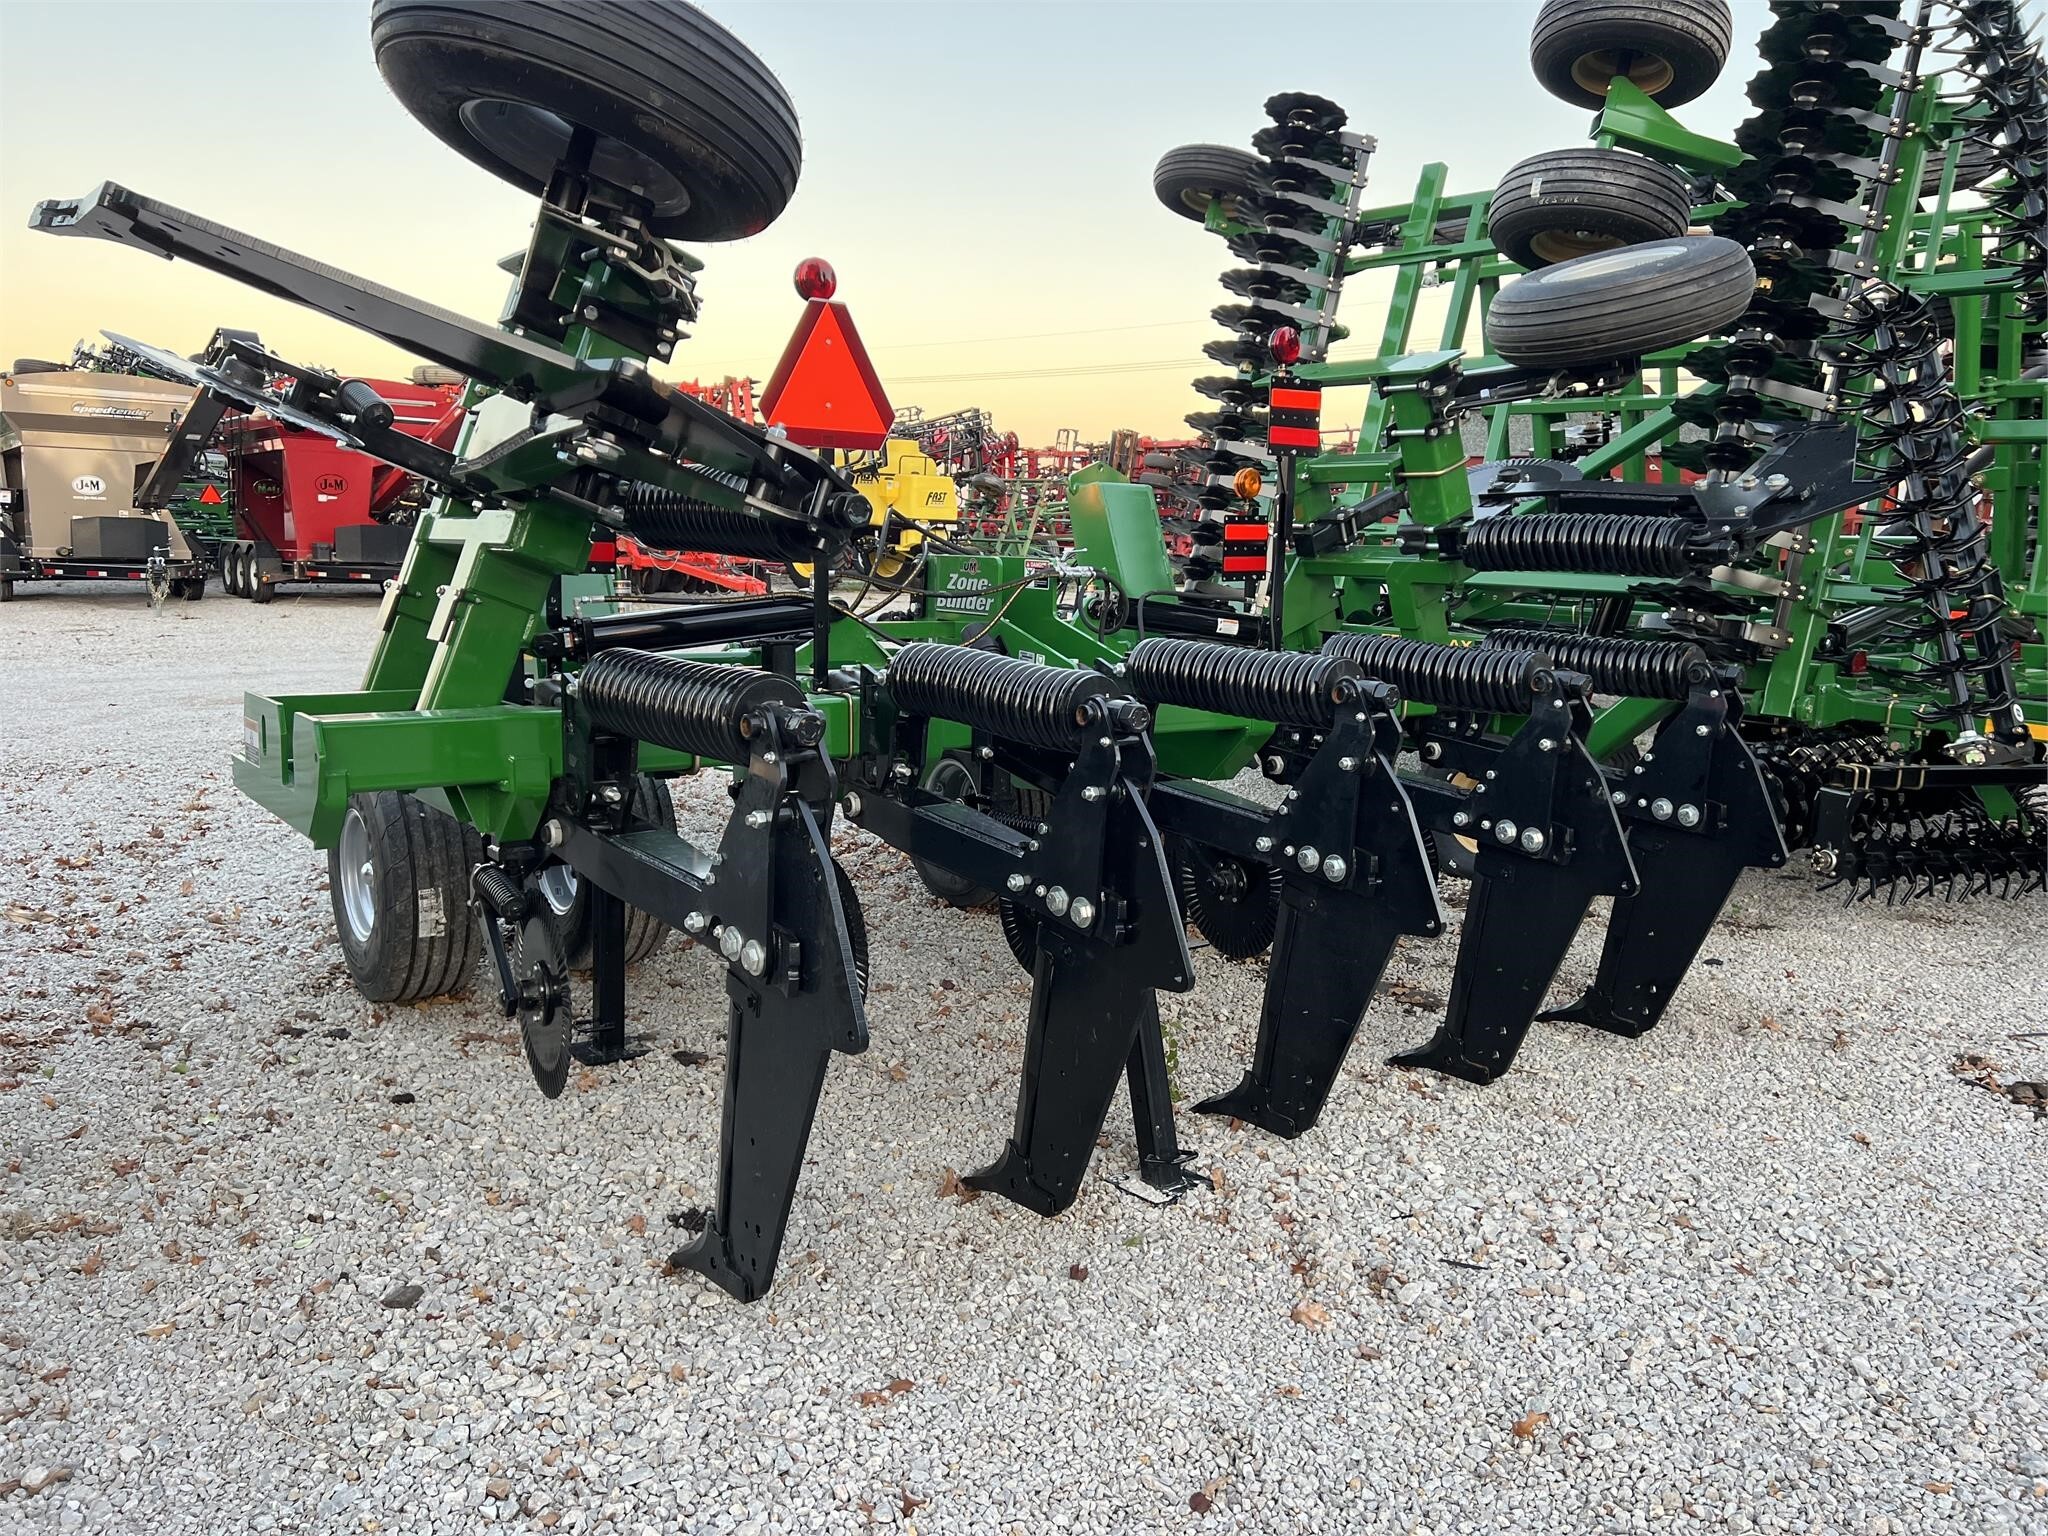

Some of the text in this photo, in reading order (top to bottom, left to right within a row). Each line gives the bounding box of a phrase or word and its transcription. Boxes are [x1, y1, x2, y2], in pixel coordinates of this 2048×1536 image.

[76, 480, 100, 491] J&M
[320, 479, 344, 491] J&M
[925, 491, 947, 505] FAST
[947, 573, 989, 591] Zone
